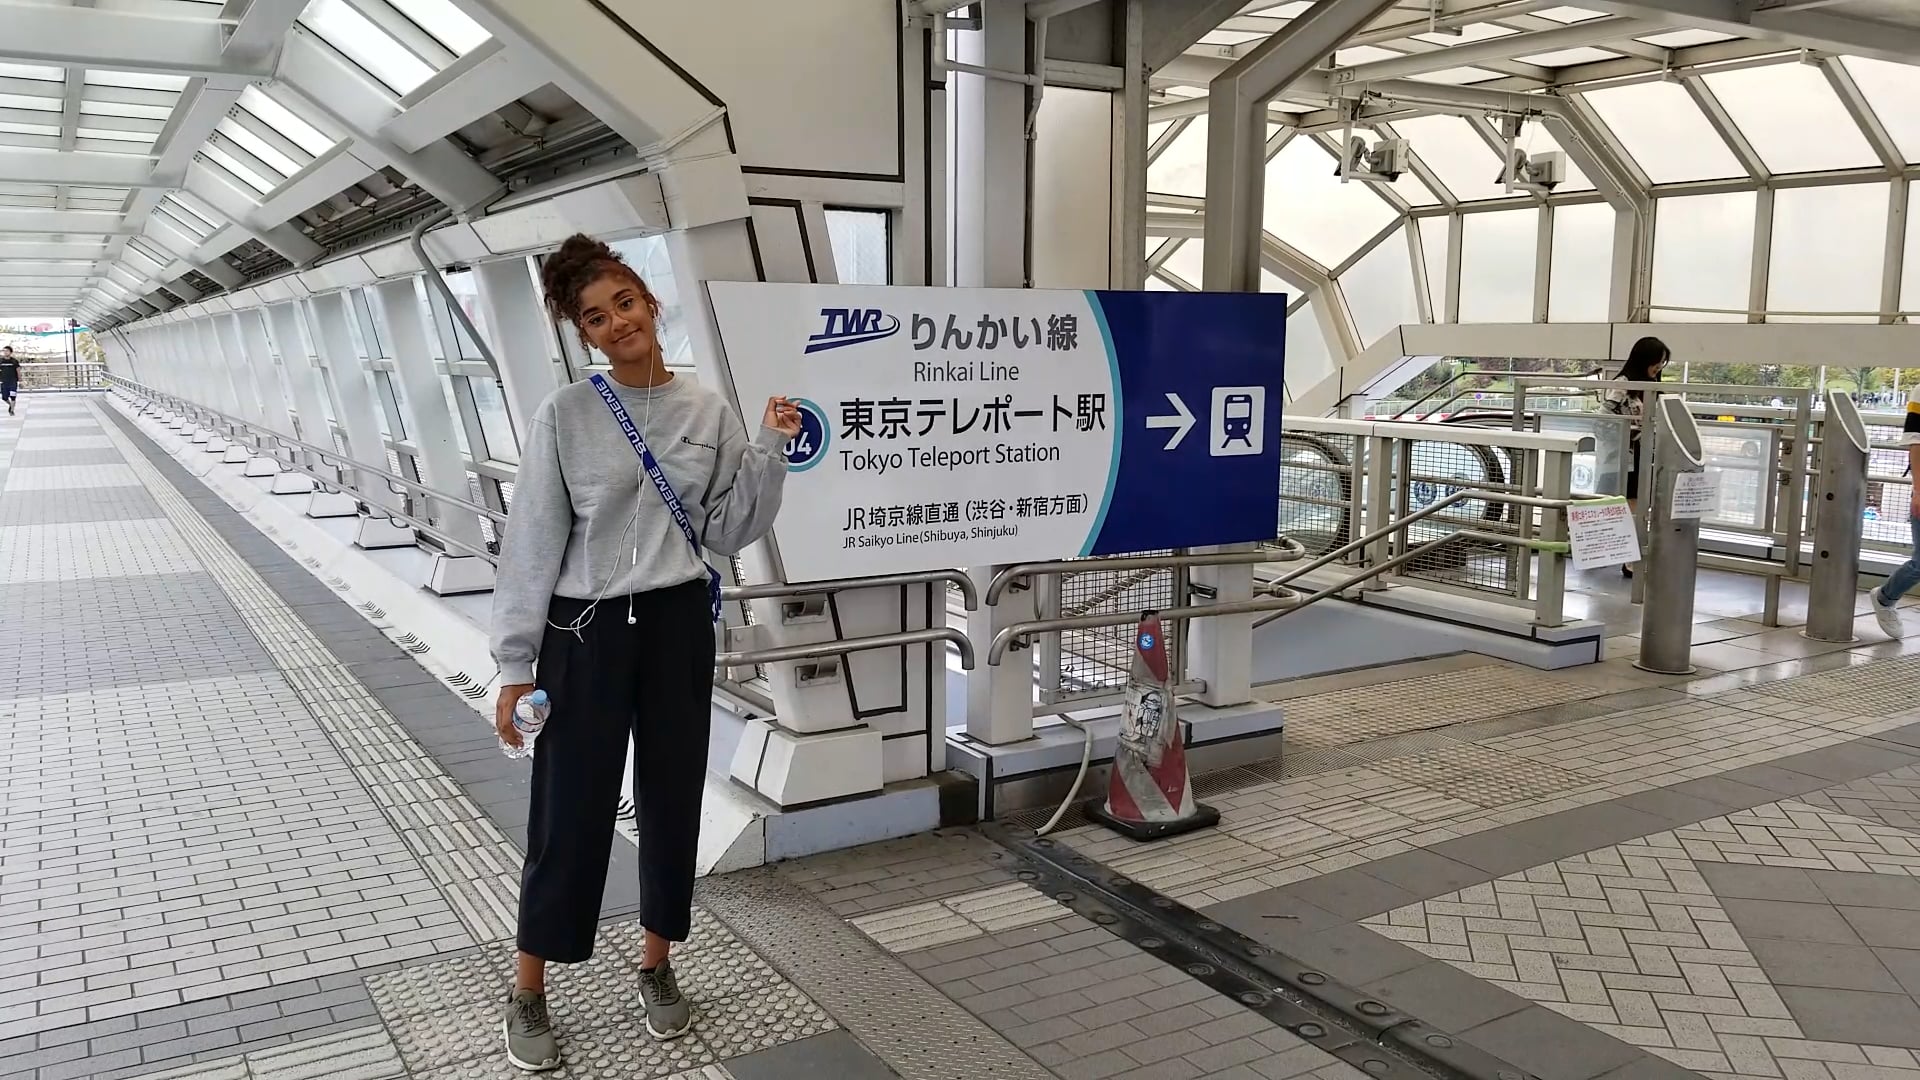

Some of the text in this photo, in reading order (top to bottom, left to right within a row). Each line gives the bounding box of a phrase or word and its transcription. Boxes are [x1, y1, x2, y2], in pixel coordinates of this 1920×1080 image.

[819, 308, 883, 337] TWR
[911, 313, 1078, 351] りんかい線
[914, 361, 1019, 382] Rinkai Line
[595, 380, 647, 455] SUPREME
[840, 393, 1106, 440] 東京テレポート駅
[839, 442, 1060, 476] Tokyo Teleport Station
[843, 536, 856, 549] JR
[858, 534, 894, 549] Saikyo
[971, 524, 1018, 541] Shinjuku)
